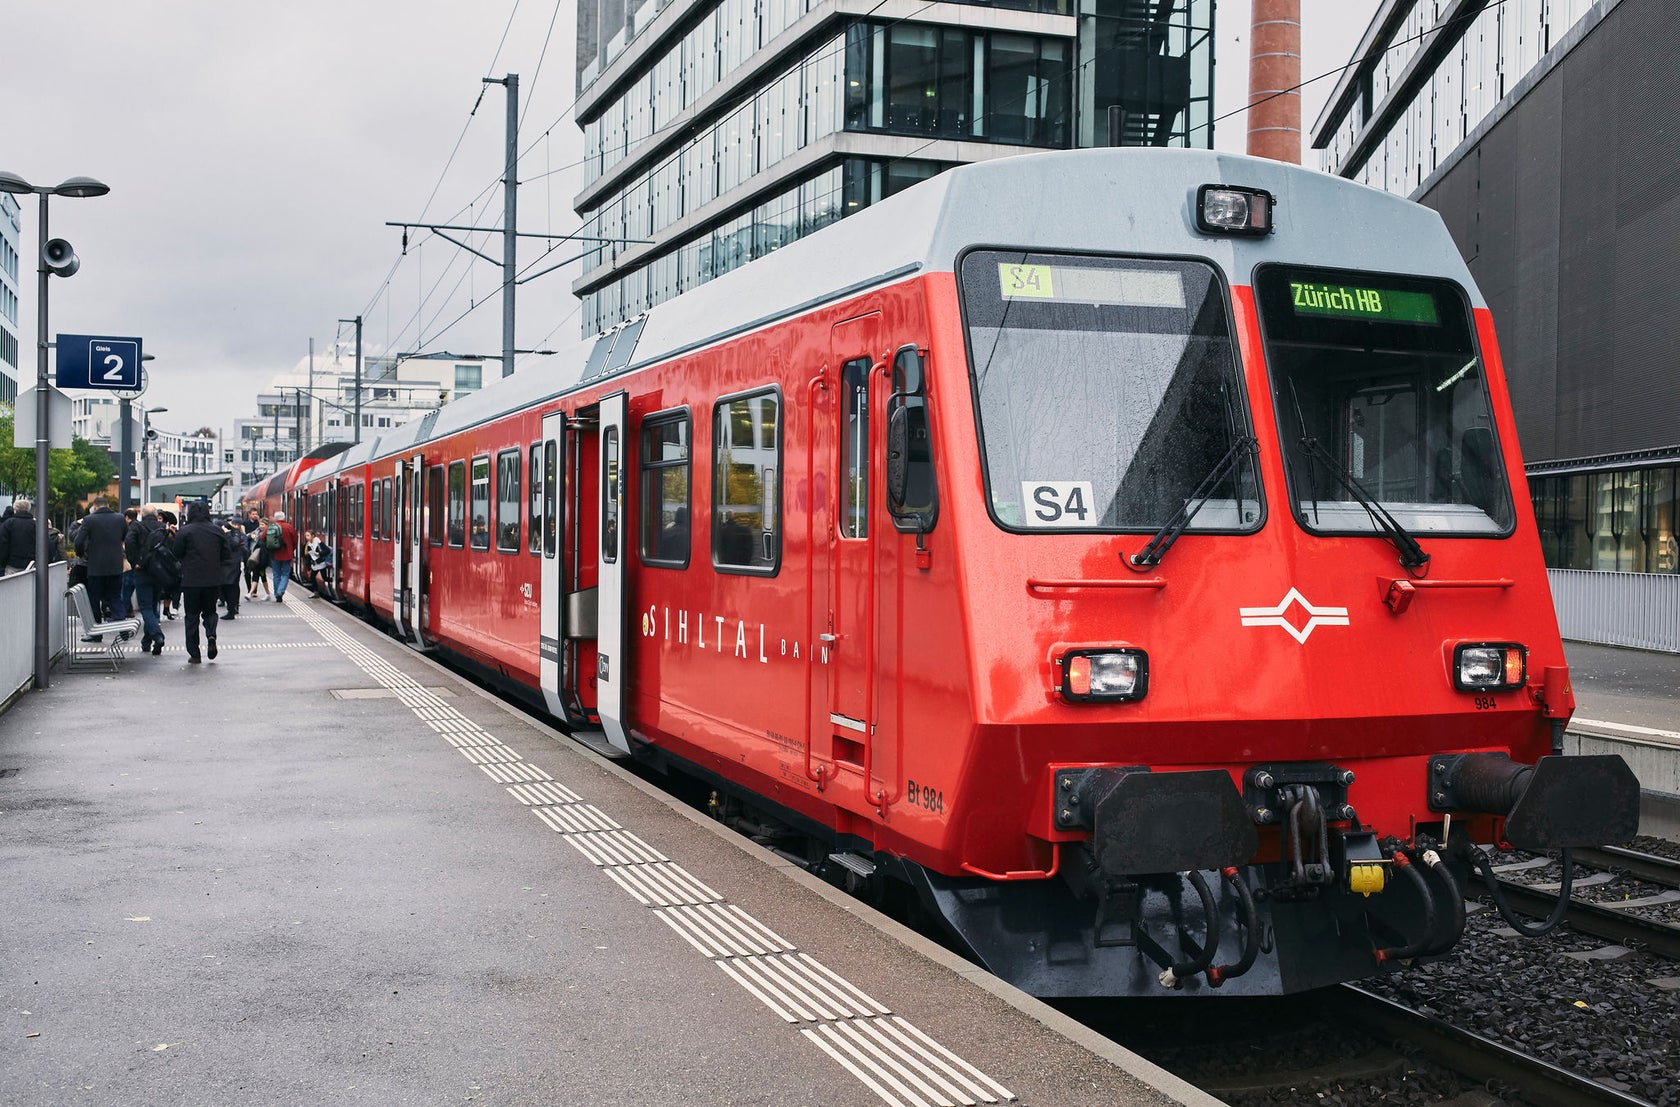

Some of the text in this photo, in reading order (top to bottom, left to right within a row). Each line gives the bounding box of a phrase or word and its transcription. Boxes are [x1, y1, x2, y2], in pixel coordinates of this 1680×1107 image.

[1009, 266, 1041, 291] S4
[1290, 283, 1383, 313] Zürich HB
[103, 354, 124, 381] 2
[1033, 485, 1088, 522] S4
[649, 604, 768, 664] SIHLTAL
[1474, 696, 1497, 710] 984
[908, 779, 943, 815] Bt 984
